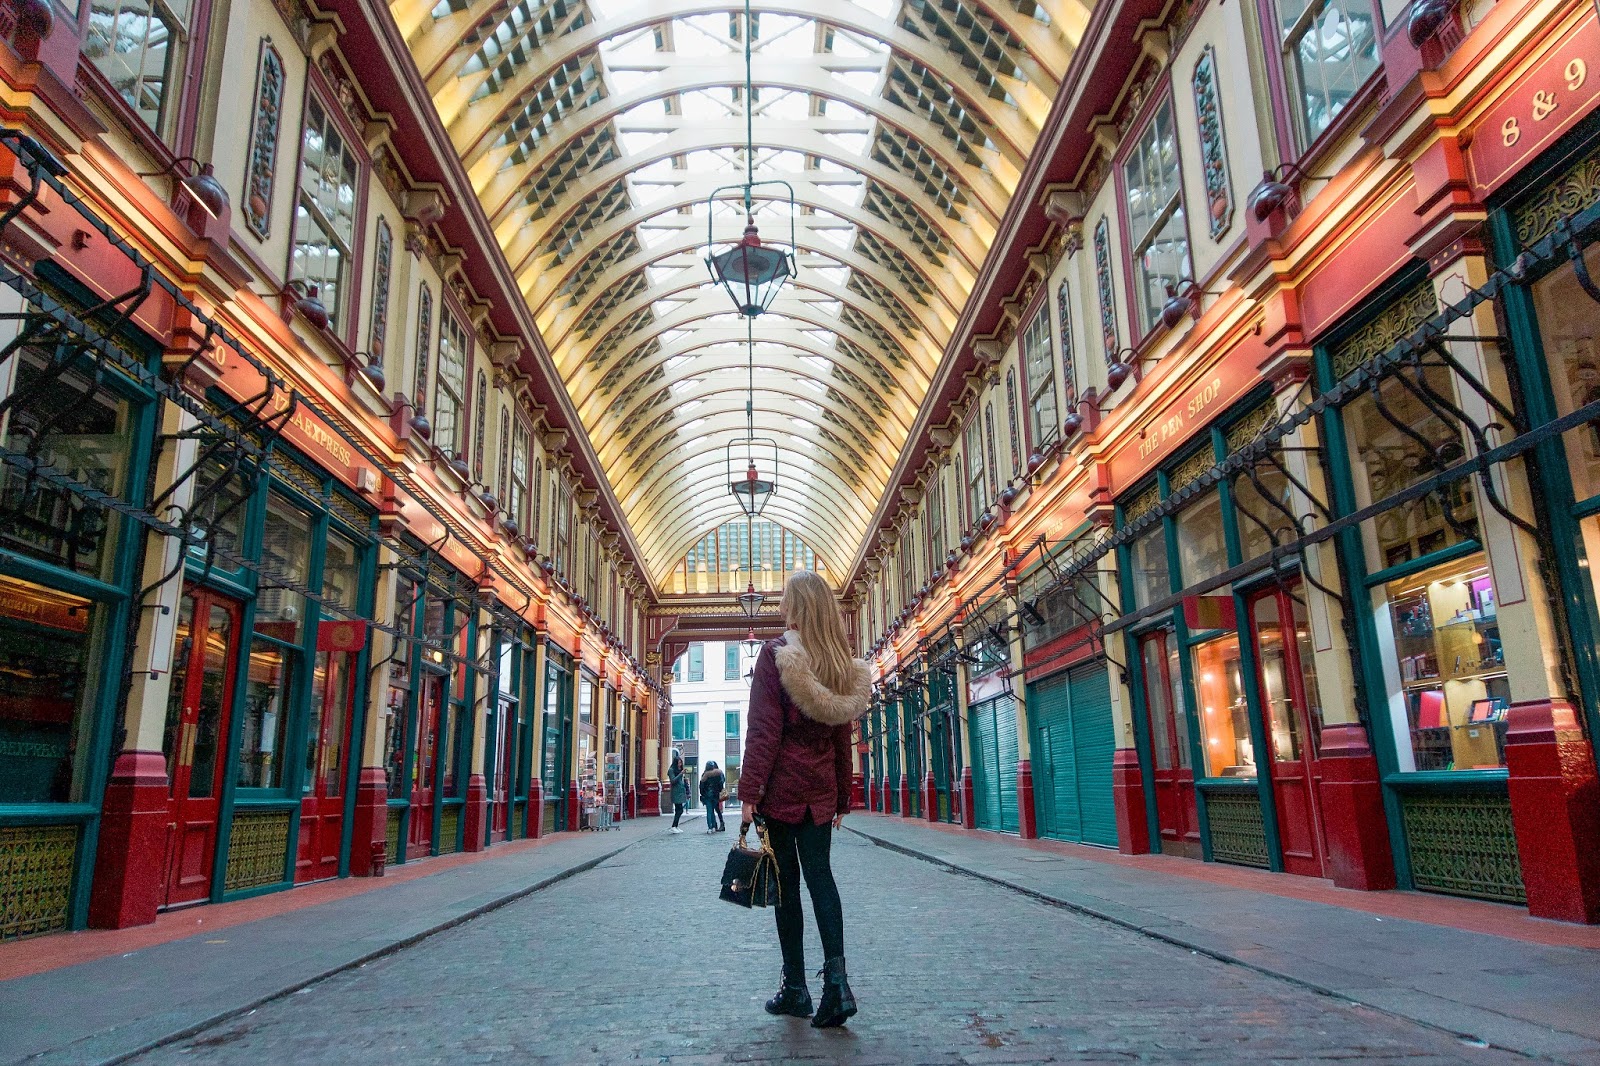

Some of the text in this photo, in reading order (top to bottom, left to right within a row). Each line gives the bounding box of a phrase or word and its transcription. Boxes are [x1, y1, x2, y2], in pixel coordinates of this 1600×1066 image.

[1501, 57, 1587, 147] 8 & 9
[1138, 377, 1221, 460] THE PEN SHOP
